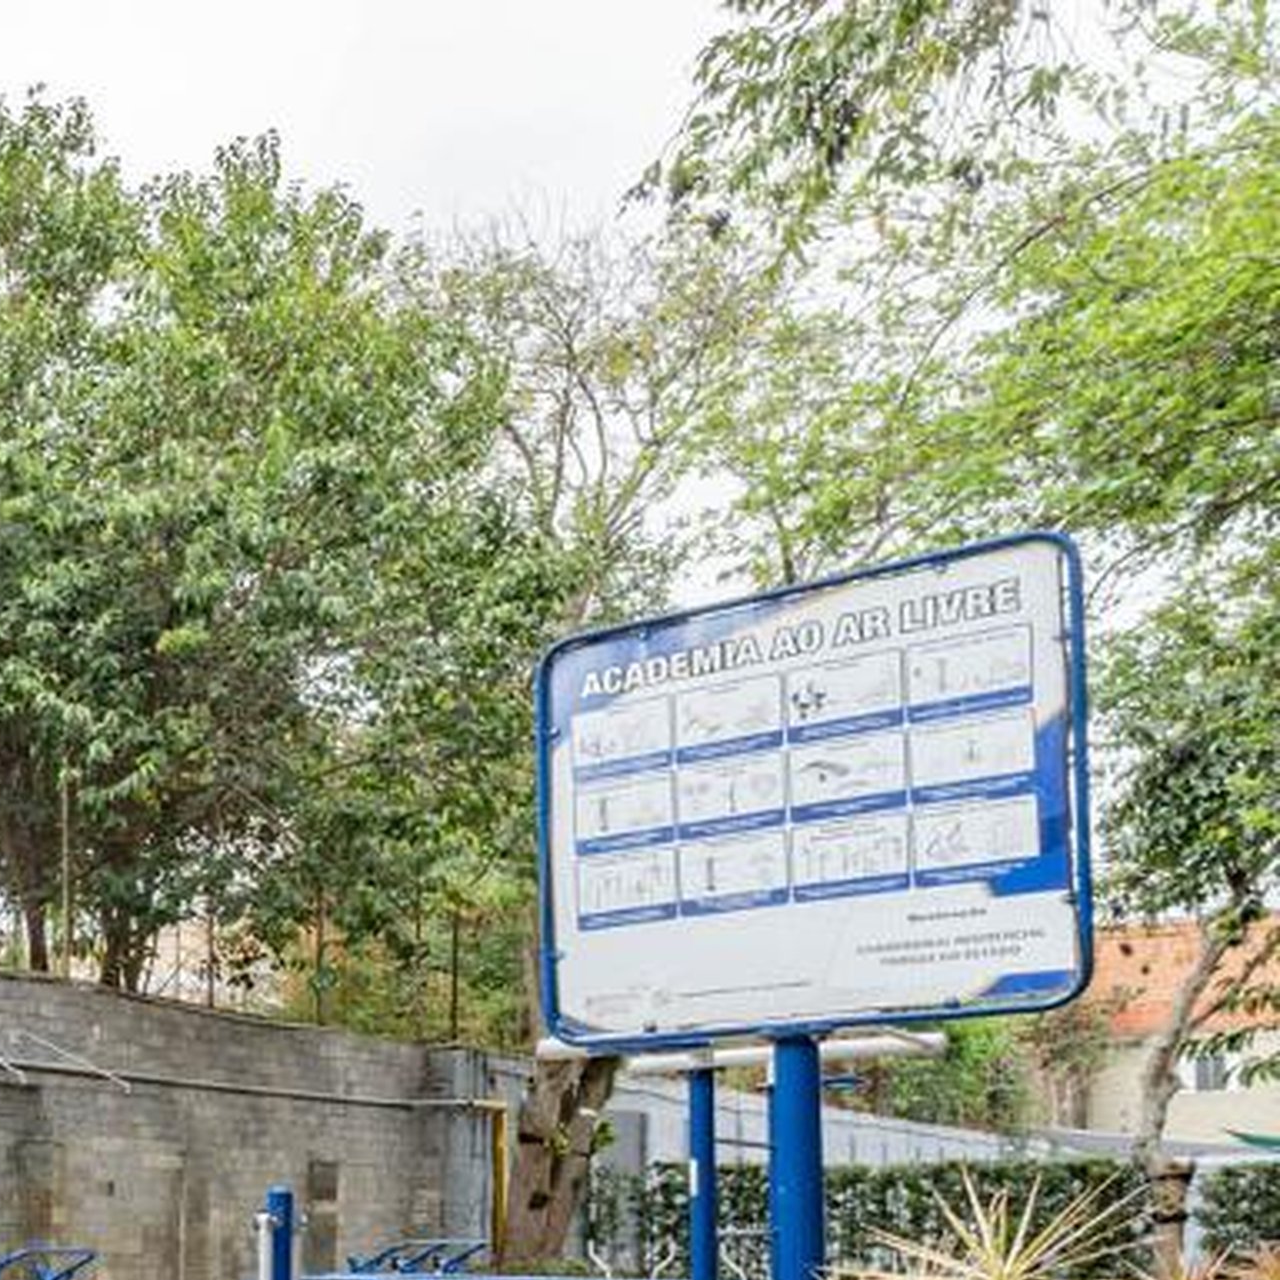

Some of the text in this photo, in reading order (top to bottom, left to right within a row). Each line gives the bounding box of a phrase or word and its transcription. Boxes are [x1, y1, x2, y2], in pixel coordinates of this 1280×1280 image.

[580, 577, 1020, 698] ACADEMIA AO AR LIVRE
